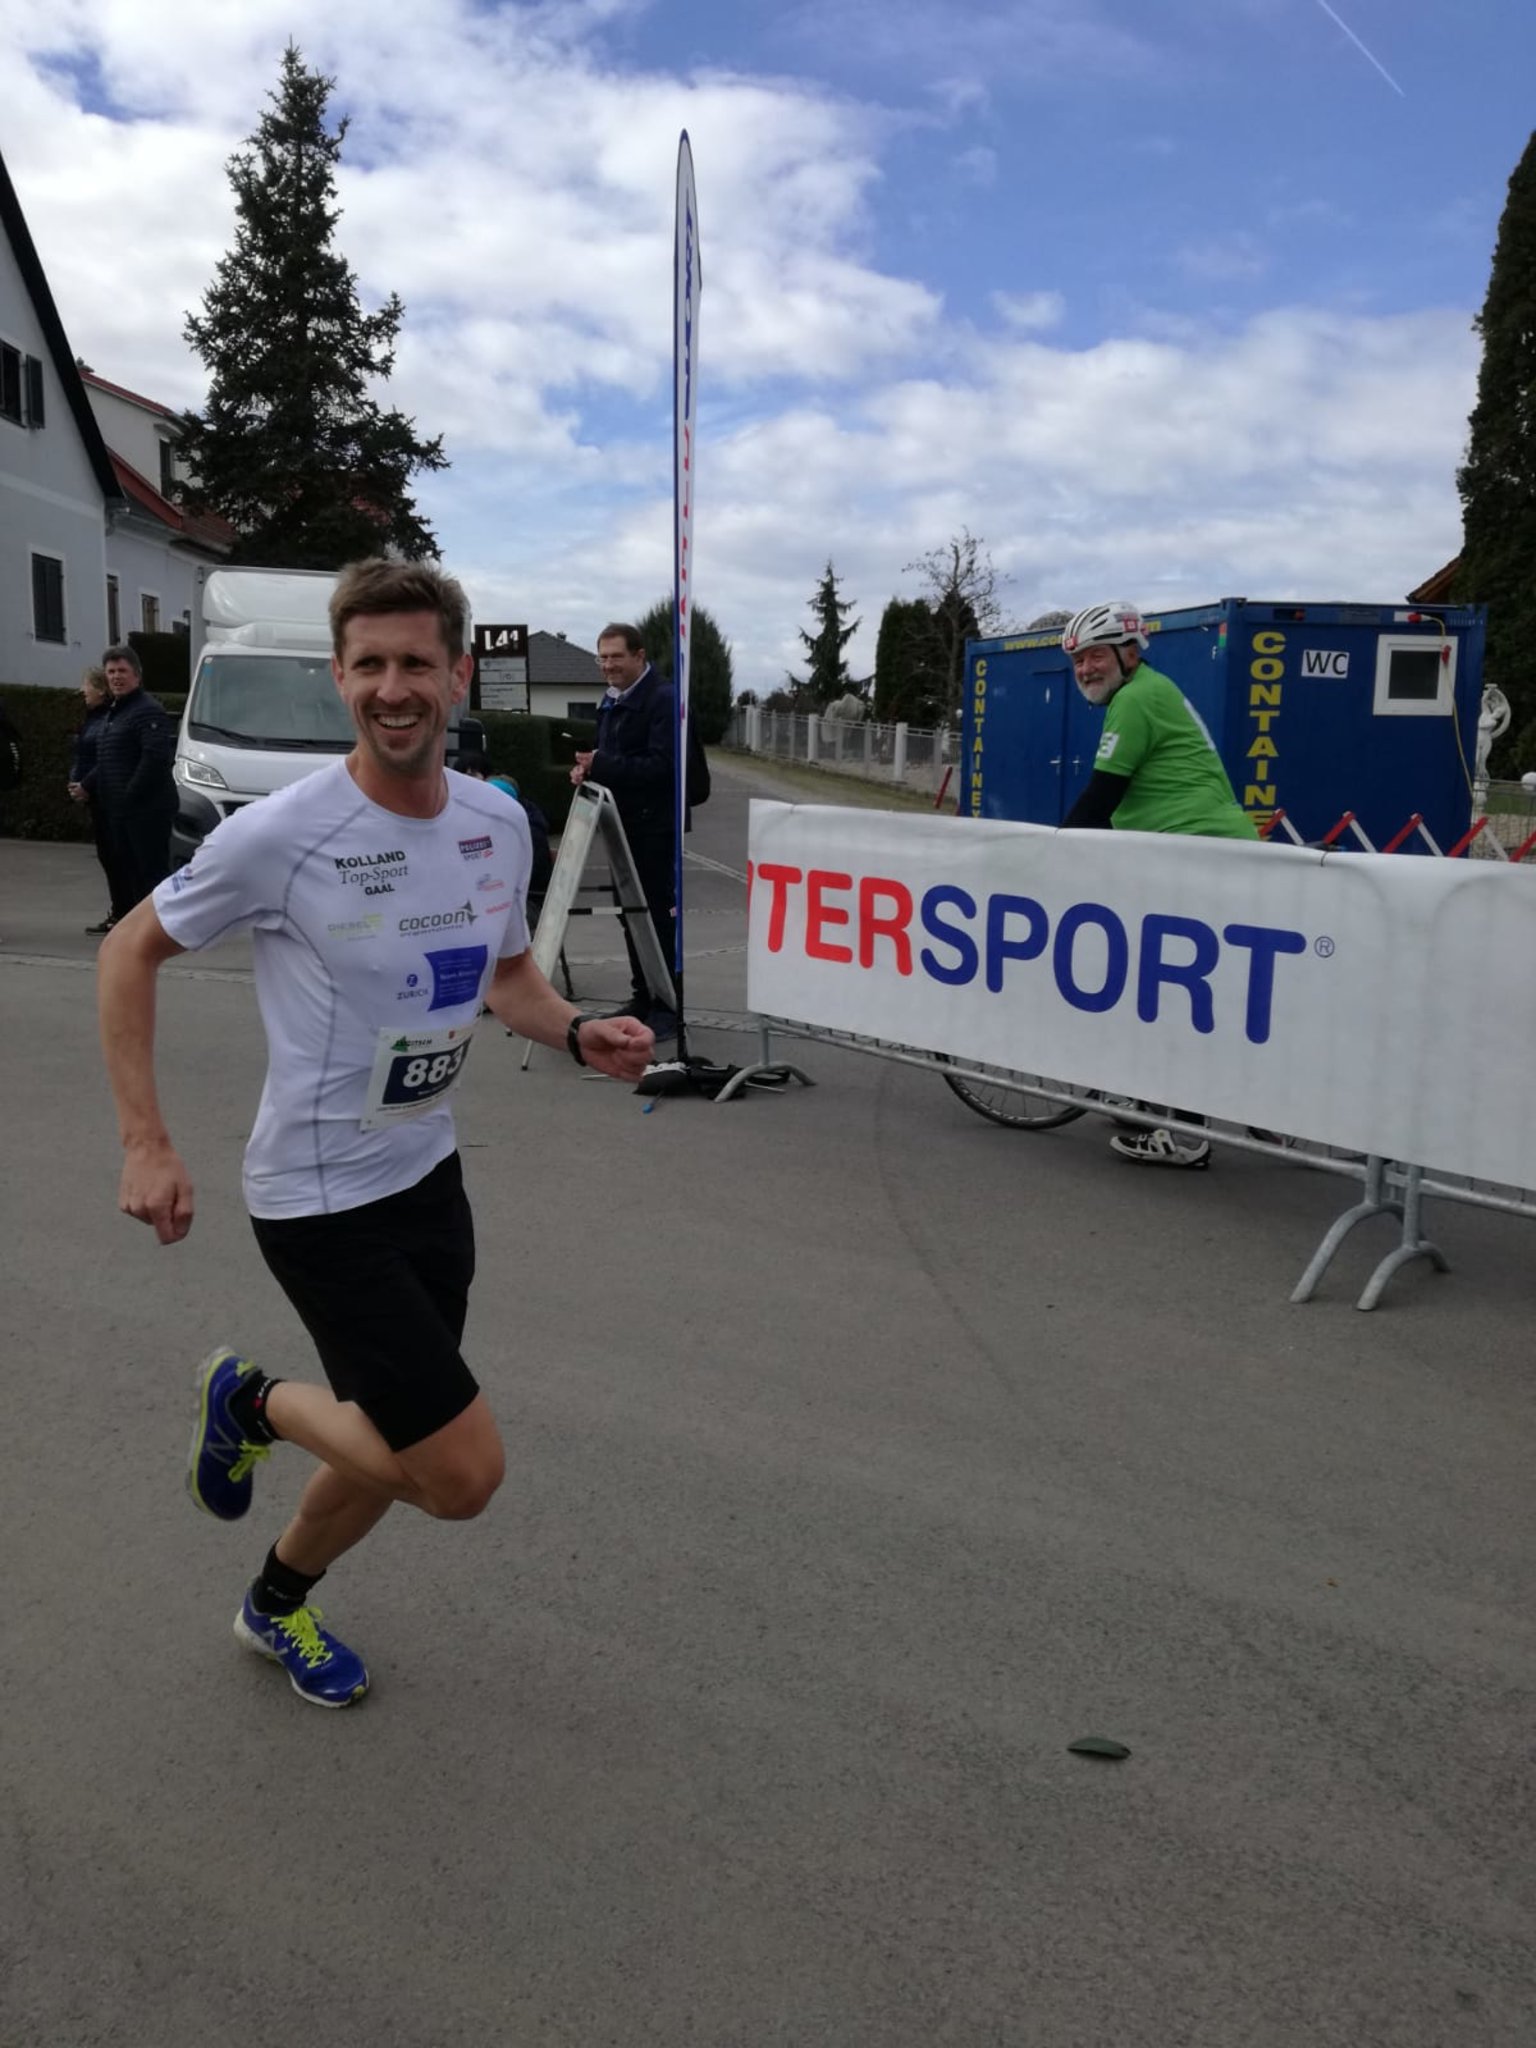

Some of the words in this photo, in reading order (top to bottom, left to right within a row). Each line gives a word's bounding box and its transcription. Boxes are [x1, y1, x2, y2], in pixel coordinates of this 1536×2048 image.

[1306, 651, 1347, 675] WC
[1245, 631, 1287, 841] CONTAINE
[335, 851, 406, 869] KOLLAND
[339, 865, 408, 886] Top-Sport
[365, 884, 395, 896] GAAL
[747, 860, 1307, 1045] TERSPORT
